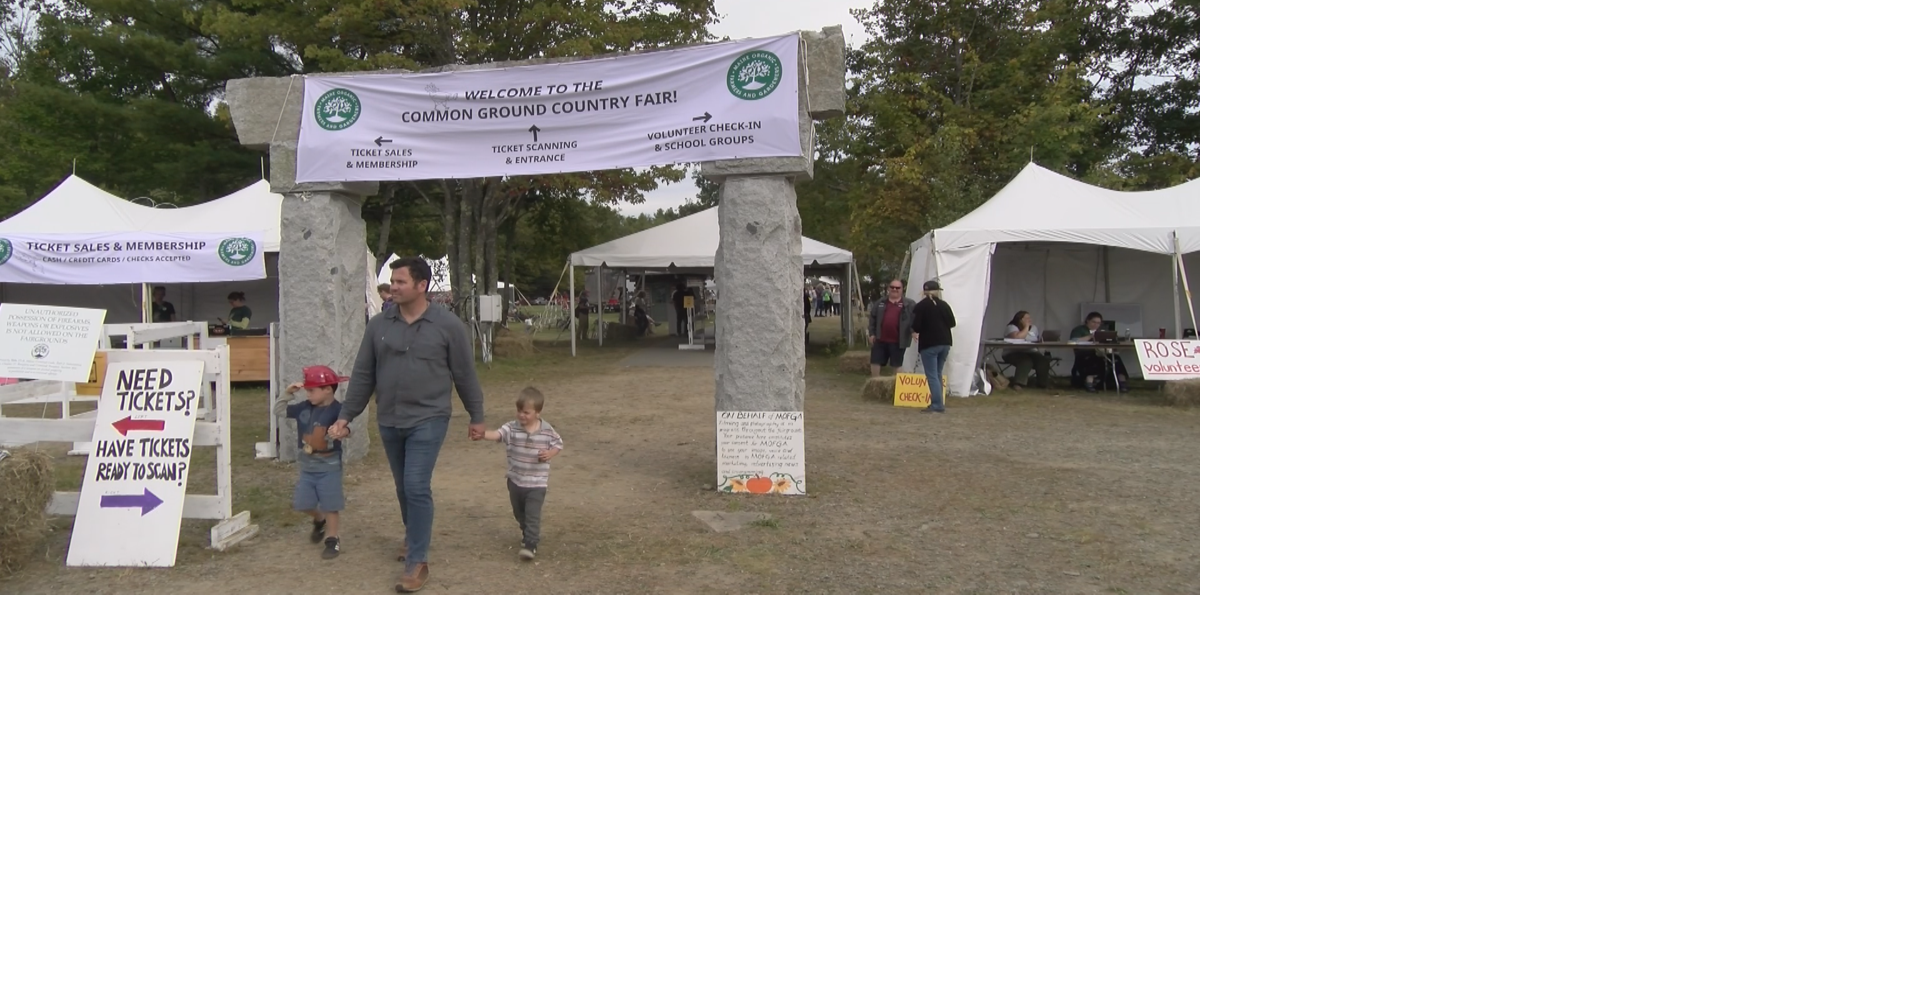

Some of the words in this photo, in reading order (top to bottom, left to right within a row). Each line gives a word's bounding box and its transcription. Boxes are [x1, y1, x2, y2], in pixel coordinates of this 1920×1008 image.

[465, 86, 542, 100] WELCOME
[547, 84, 568, 94] TO
[573, 80, 603, 92] THE
[402, 108, 472, 122] COMMON
[478, 104, 546, 120] GROUND
[552, 96, 630, 114] COUNTRY
[635, 90, 678, 107] FAIR!
[648, 125, 706, 140] VOLUNTEER
[709, 120, 761, 132] CHECK-IN
[492, 144, 524, 153] TICKET
[526, 141, 578, 152] SCANNING
[664, 139, 706, 150] SCHOOL
[709, 136, 754, 146] GROUPS
[356, 160, 418, 168] MEMBERSHIP
[515, 154, 566, 164] ENTRANCE
[26, 242, 70, 252] TICKET
[74, 242, 110, 252] SALES
[114, 242, 122, 252] &
[126, 242, 206, 250] MEMBERSHIP
[25, 308, 78, 316] UNAUTHORIZED
[20, 336, 68, 344] FAIRGROUNDS
[1143, 341, 1195, 358] ROSE
[116, 368, 172, 390] NEED
[116, 390, 196, 416] TICKETS?
[775, 412, 802, 422] MOFGA
[96, 439, 134, 458] HAVE
[139, 438, 190, 458] TICKETS
[96, 462, 130, 482] READY
[132, 462, 146, 480] TO
[147, 462, 186, 486] SCAN?
